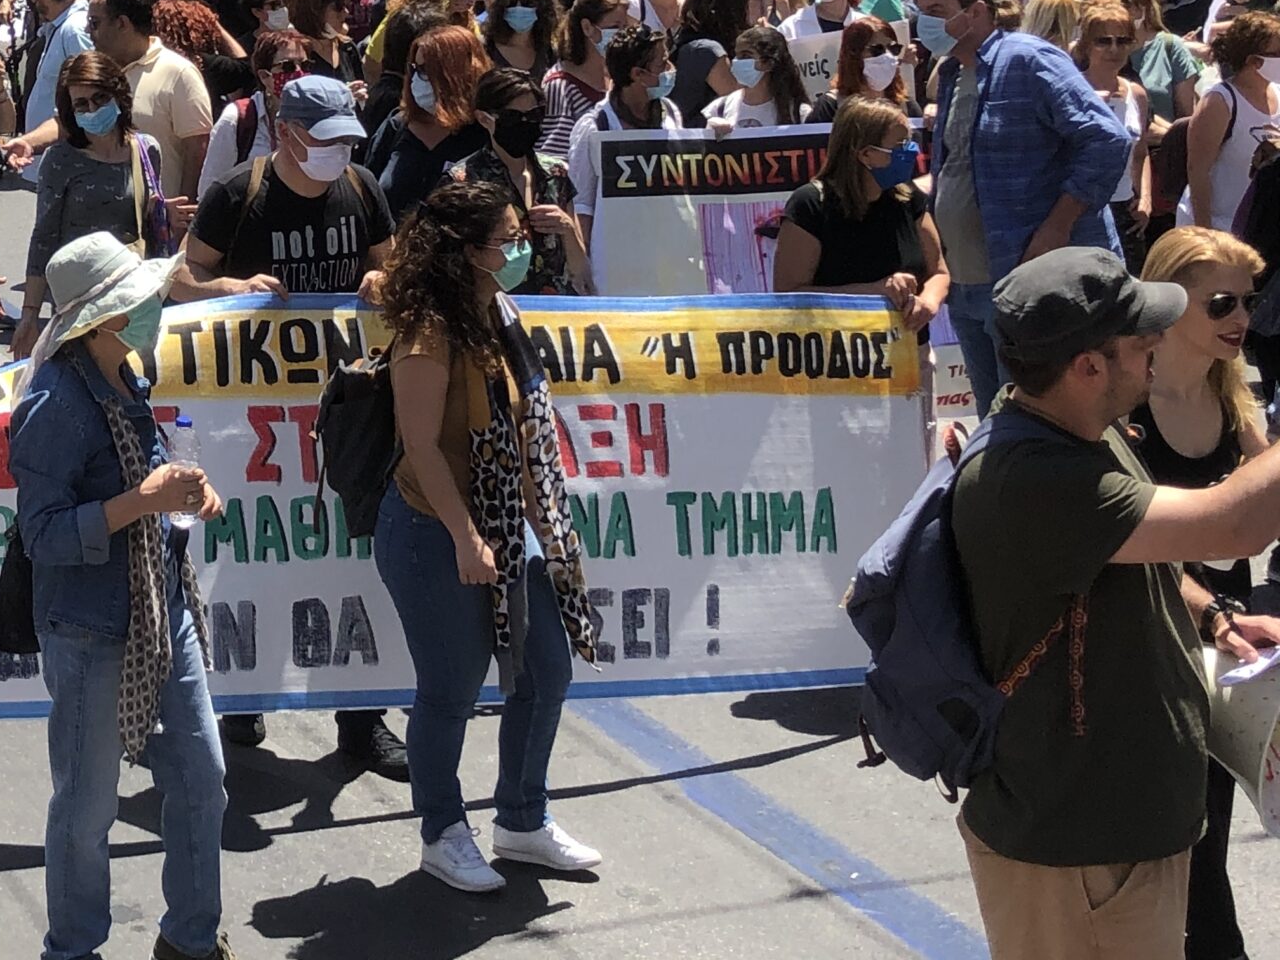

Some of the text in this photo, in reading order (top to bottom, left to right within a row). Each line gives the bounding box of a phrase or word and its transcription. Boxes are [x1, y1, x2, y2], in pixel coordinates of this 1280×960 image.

[615, 148, 827, 189] ΣΥΝΤΟΝΙΣΤΙ
[271, 215, 358, 261] not oil
[271, 256, 360, 292] EXTRACTION
[665, 486, 839, 560] ΤΜΗΜΑ
[292, 594, 380, 669] ΘΑ
